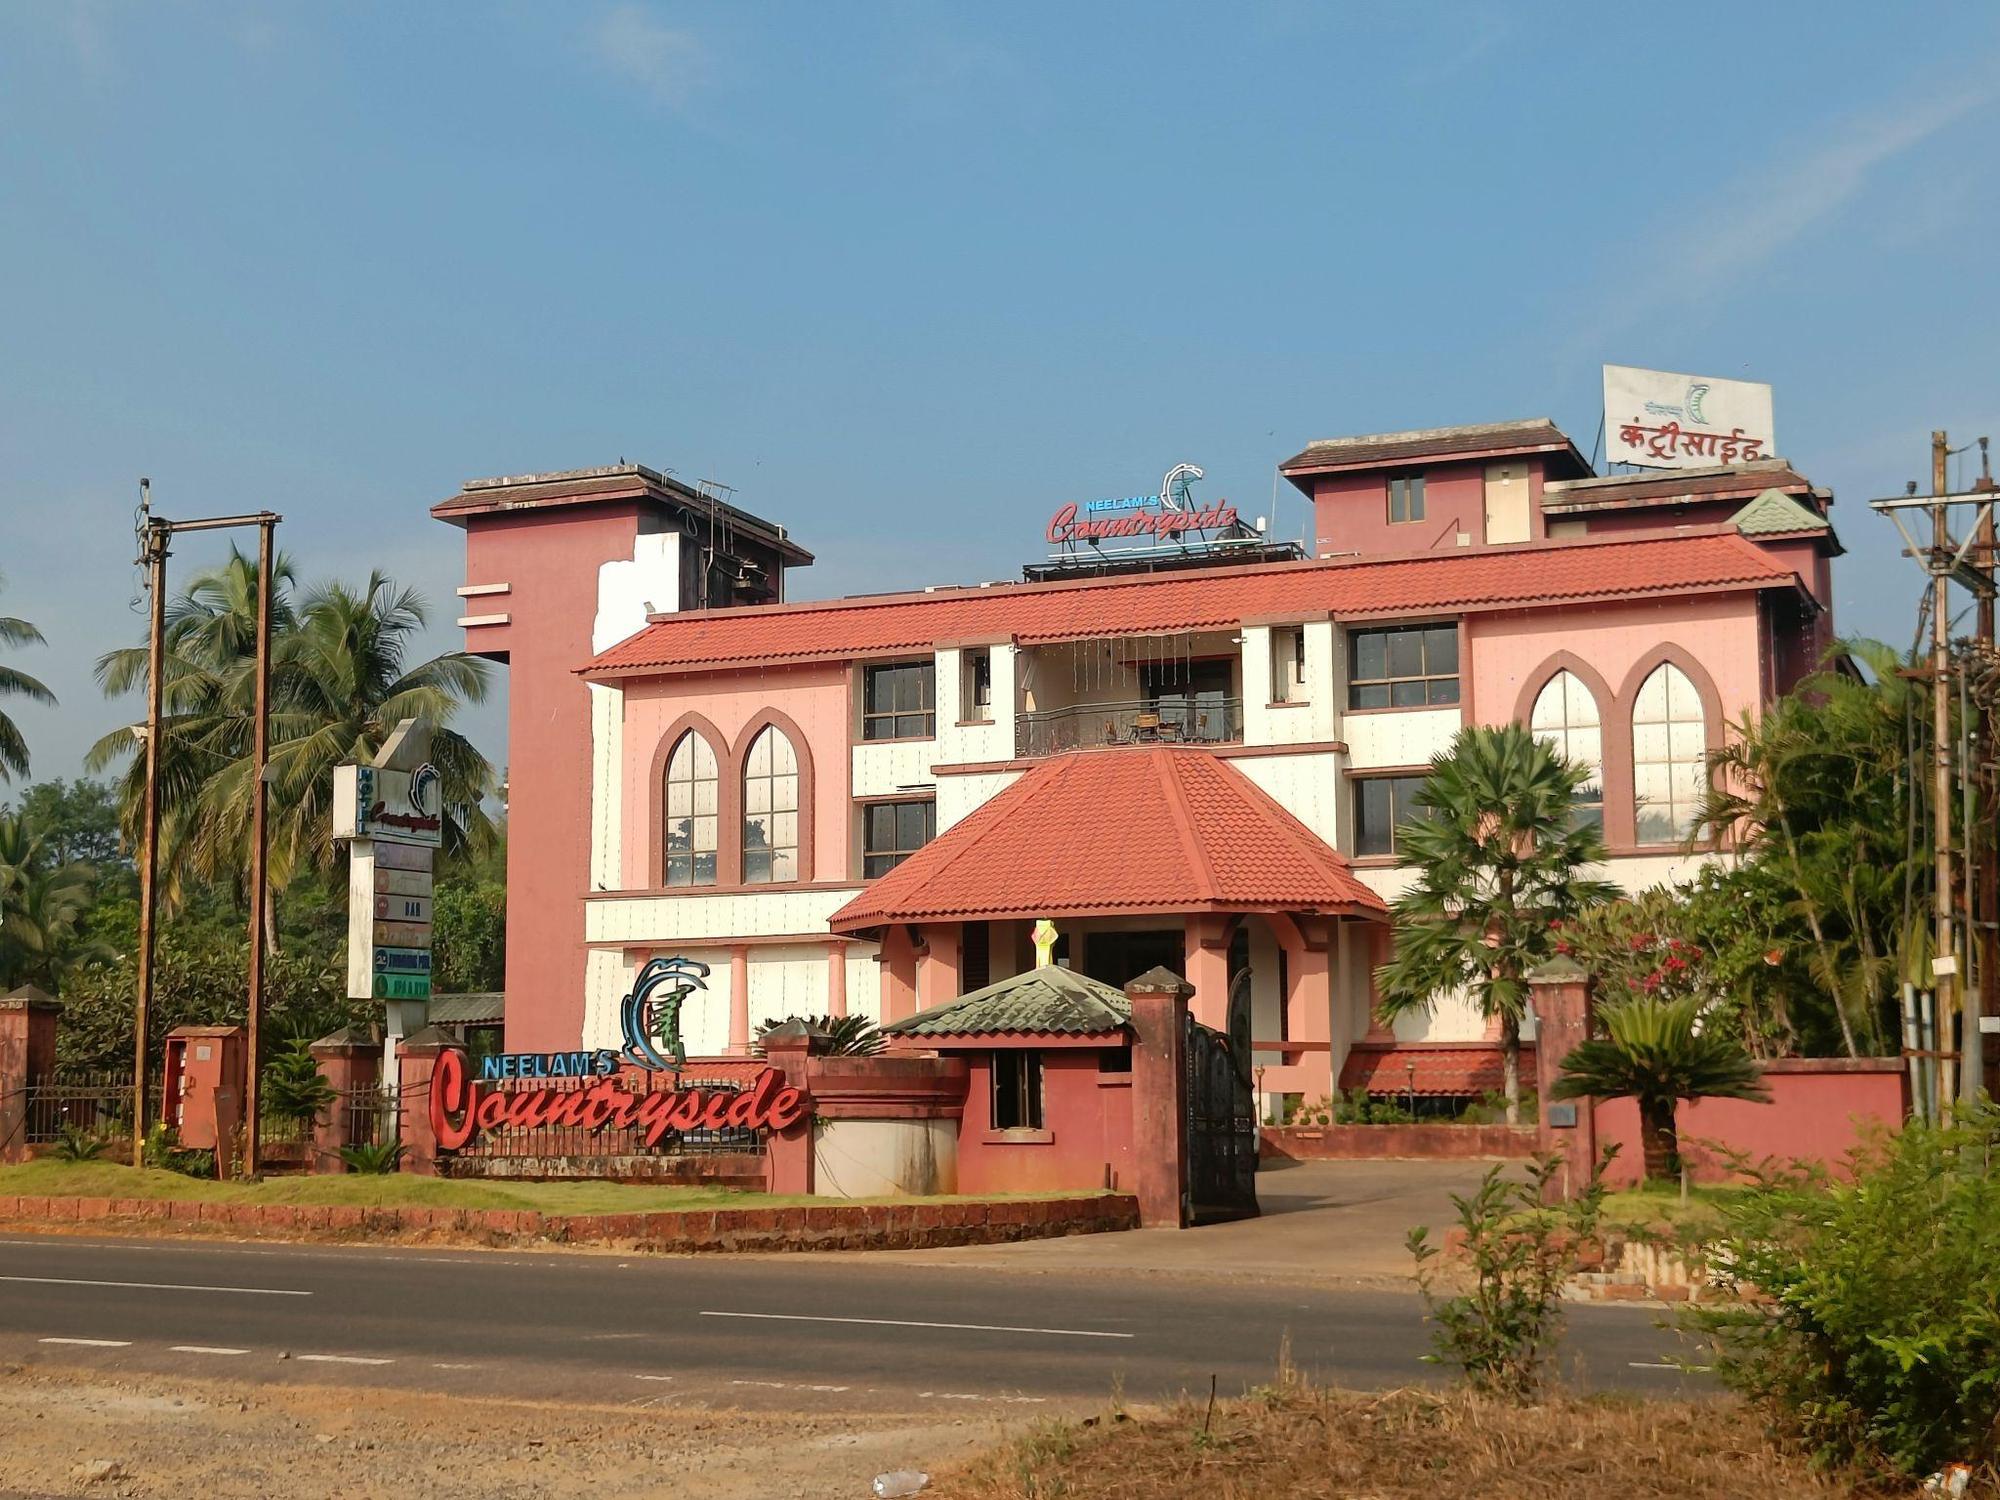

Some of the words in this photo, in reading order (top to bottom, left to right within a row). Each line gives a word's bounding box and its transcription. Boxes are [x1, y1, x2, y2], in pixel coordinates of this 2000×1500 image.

[1086, 496, 1158, 511] NEELAM'S
[1046, 499, 1237, 543] Countryside
[405, 901, 421, 917] BAR
[430, 1049, 804, 1149] Countryside
